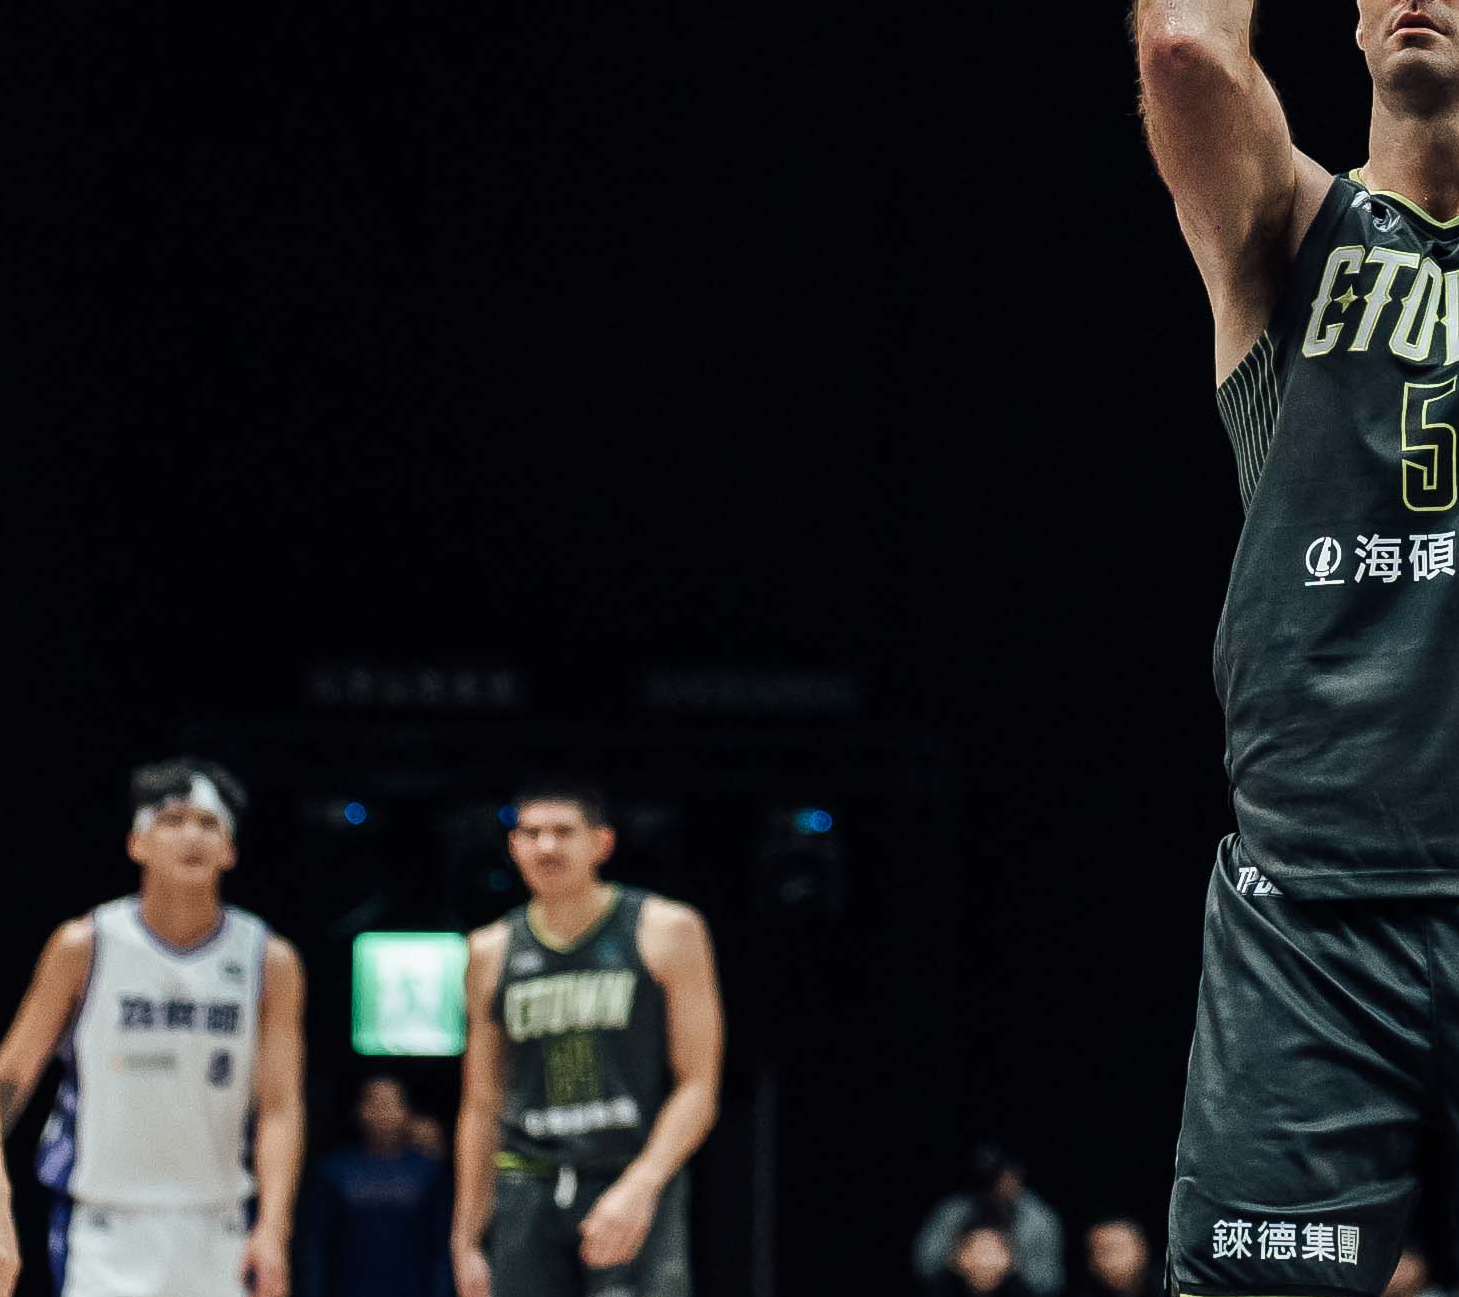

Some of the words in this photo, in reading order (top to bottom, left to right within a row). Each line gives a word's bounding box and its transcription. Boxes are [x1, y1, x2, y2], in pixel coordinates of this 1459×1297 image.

[1401, 375, 1459, 512] 5
[1212, 1218, 1360, 1266] 錸德集團
